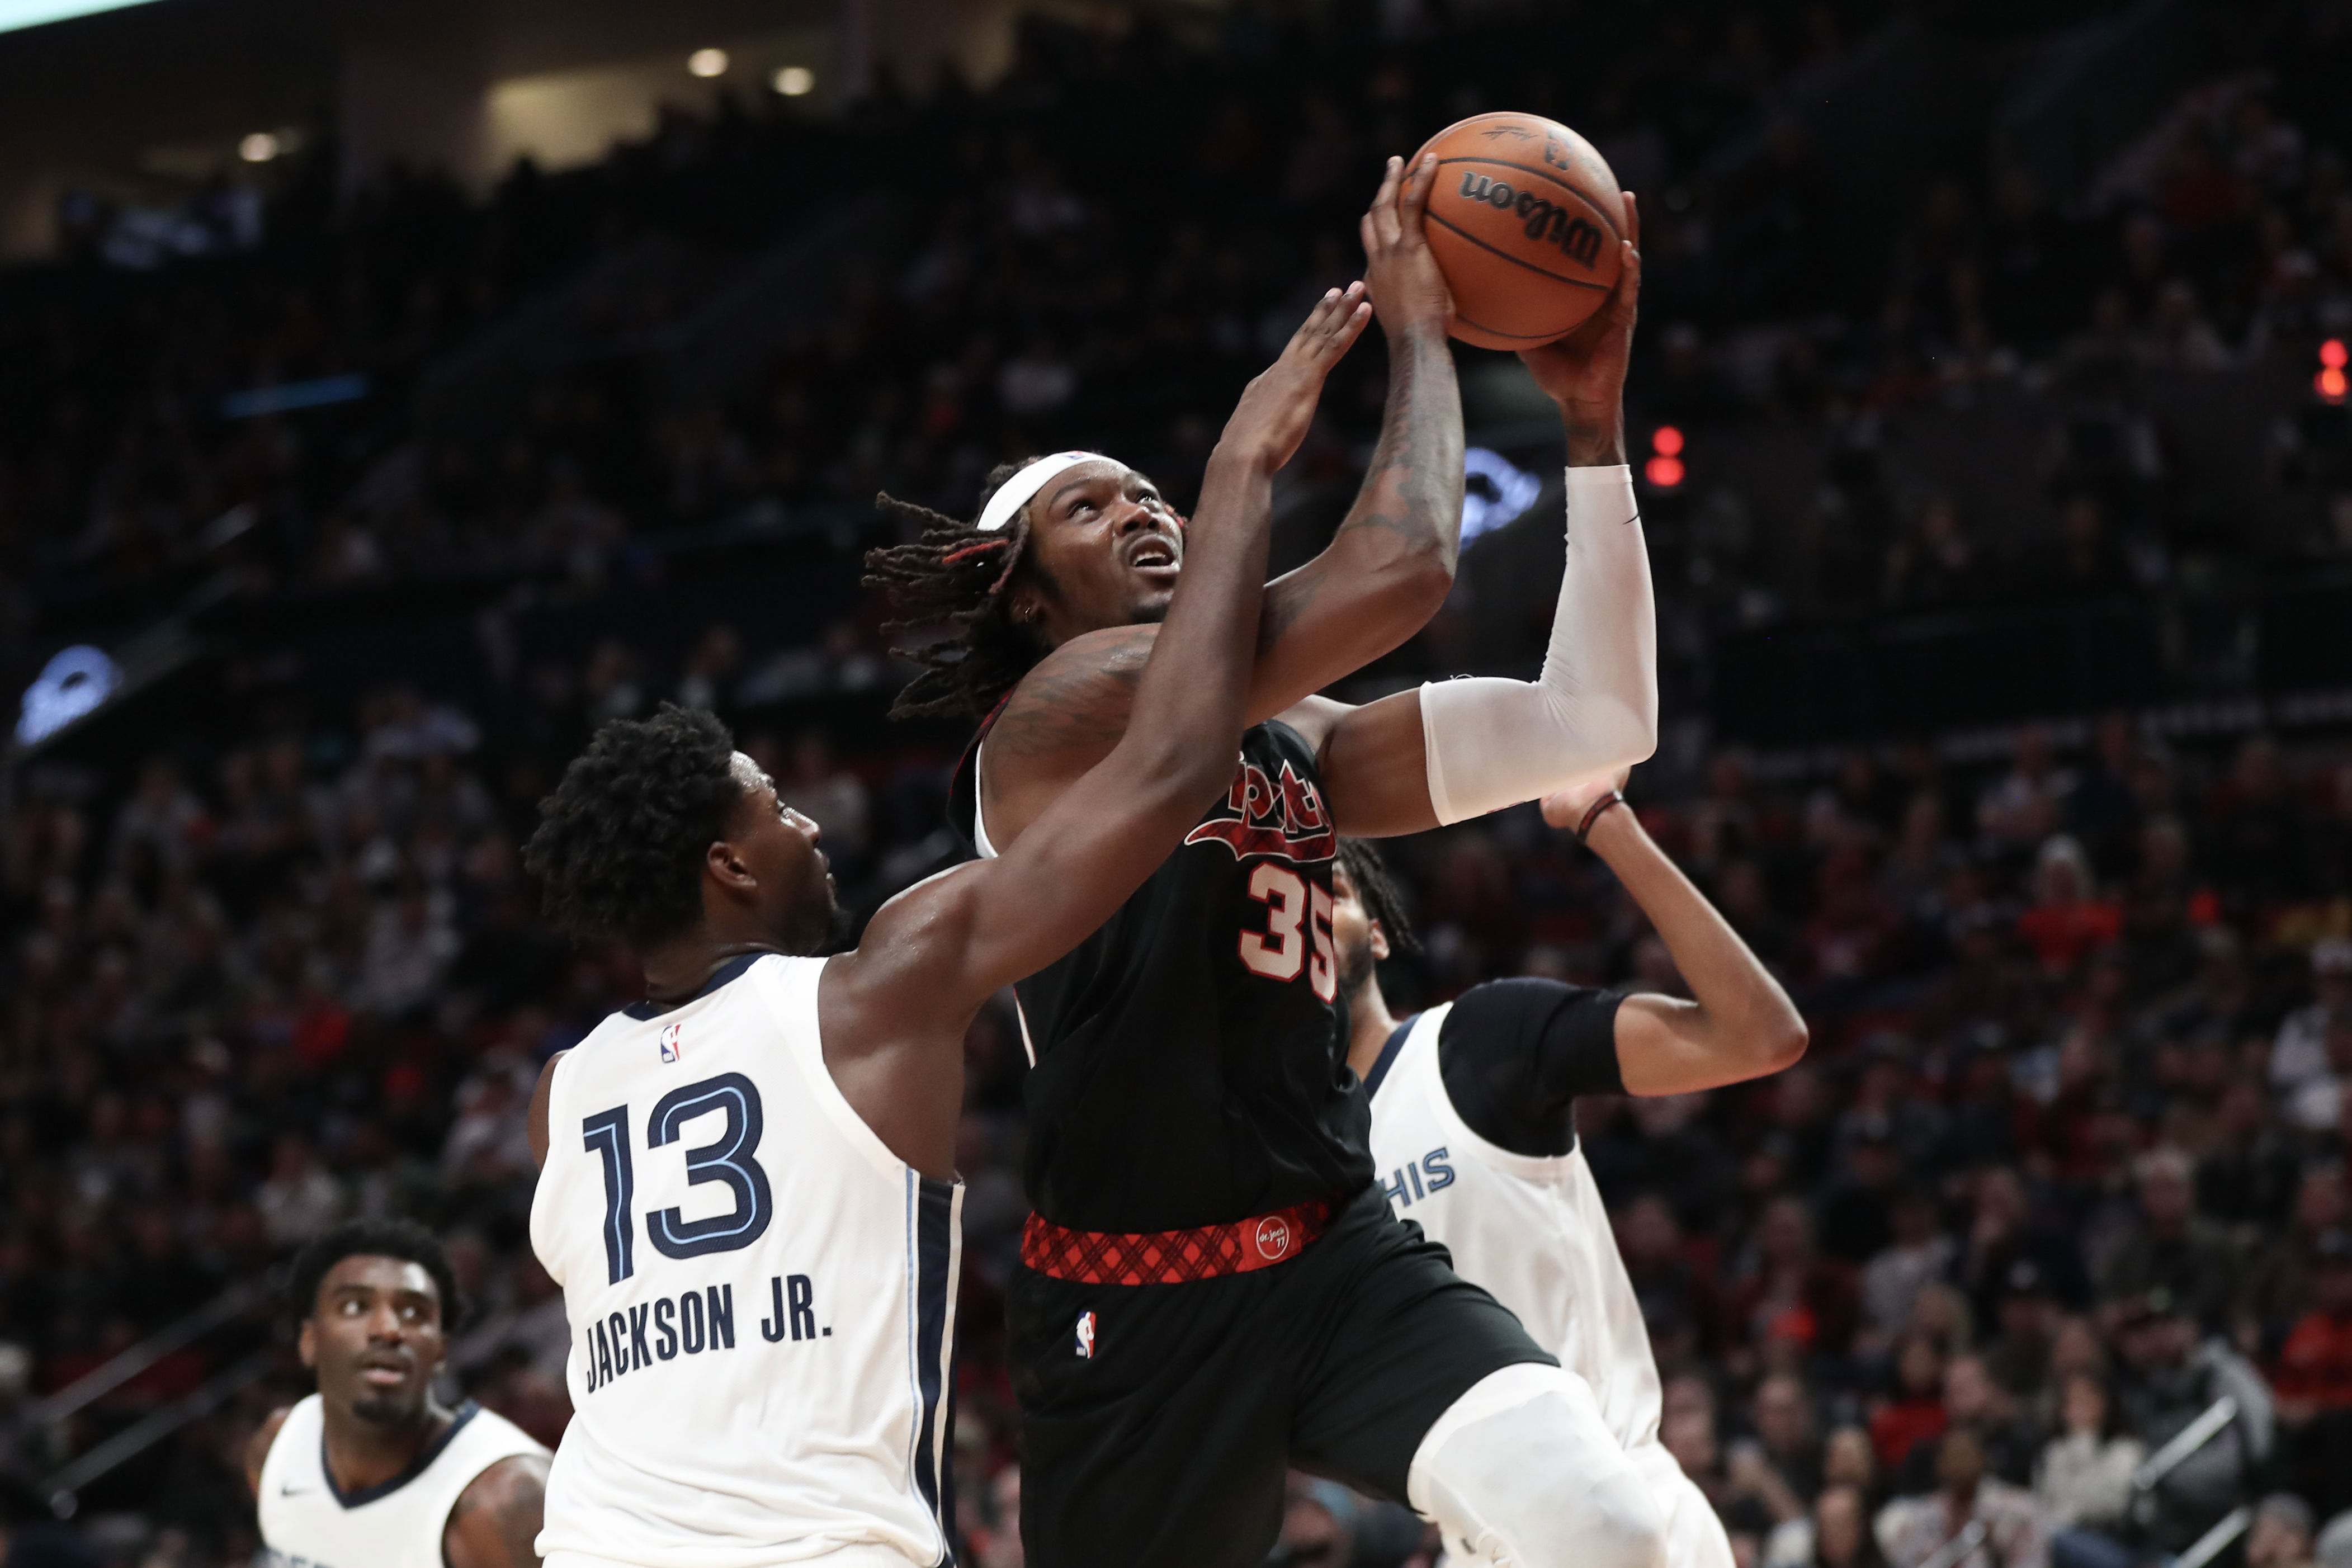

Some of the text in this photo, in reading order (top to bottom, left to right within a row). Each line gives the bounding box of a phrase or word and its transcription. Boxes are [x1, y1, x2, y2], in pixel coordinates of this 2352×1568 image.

[1458, 170, 1603, 271] Wilson
[1238, 861, 1338, 1004] 35
[583, 1072, 773, 1287] 13
[587, 1274, 832, 1395] JACKSON JR.
